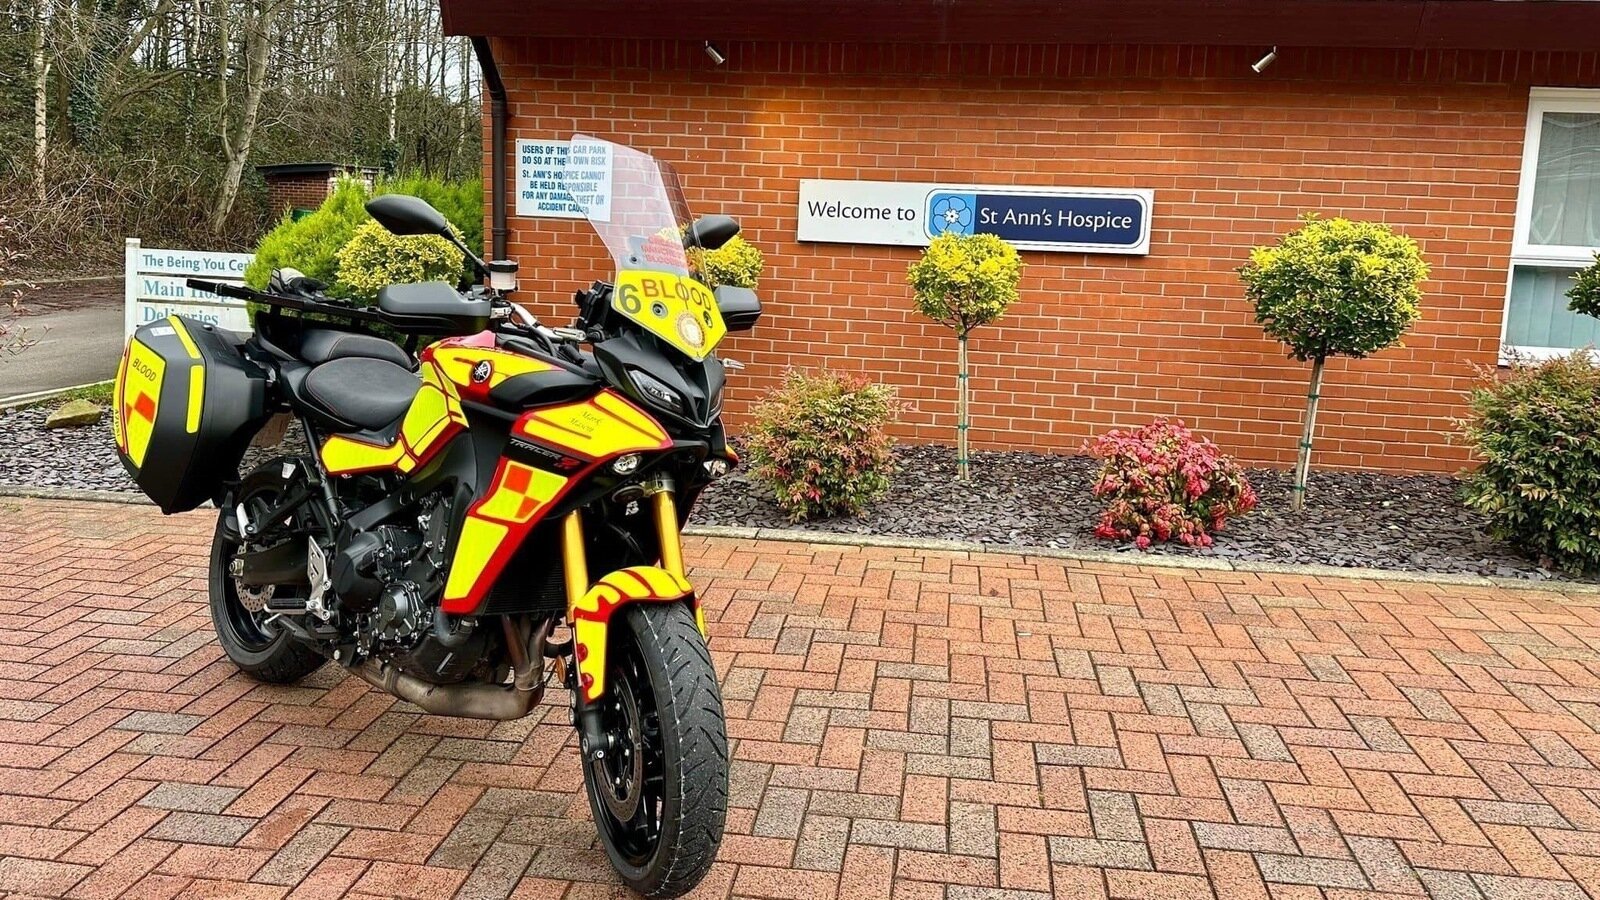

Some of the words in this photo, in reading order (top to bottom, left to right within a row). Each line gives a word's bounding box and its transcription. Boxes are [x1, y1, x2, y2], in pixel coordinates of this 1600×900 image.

[522, 144, 544, 155] USERS
[545, 146, 554, 155] OF
[572, 145, 587, 154] CAR
[588, 146, 606, 155] PARK
[522, 156, 532, 164] DO
[533, 156, 543, 165] SO
[544, 156, 552, 165] AT
[574, 156, 588, 166] OWN
[590, 156, 606, 166] RISK
[522, 169, 530, 178] St.
[532, 171, 552, 179] ANN'S
[553, 171, 579, 180] HOSPICE
[580, 171, 606, 180] CANNOT
[530, 181, 538, 189] BE
[540, 182, 556, 190] HELD
[558, 182, 598, 192] RESPONSIBLE
[522, 191, 534, 200] FOR
[536, 192, 548, 200] ANY
[576, 195, 594, 205] THEFT
[596, 195, 604, 205] OR
[538, 202, 566, 212] ACCIDENT
[568, 204, 590, 214] CAUED
[808, 201, 891, 220] Welcome
[896, 208, 916, 221] to
[980, 207, 999, 225] St
[1003, 209, 1053, 227] Ann's
[1058, 211, 1133, 232] Hospice
[143, 254, 164, 267] The
[167, 256, 200, 272] Being
[202, 258, 225, 271] You
[143, 279, 184, 297] Main
[642, 279, 712, 311] BLOOD
[619, 284, 642, 314] 6
[144, 307, 219, 325] Deleries
[132, 358, 156, 382] BLOOD
[510, 438, 562, 460] TRACER
